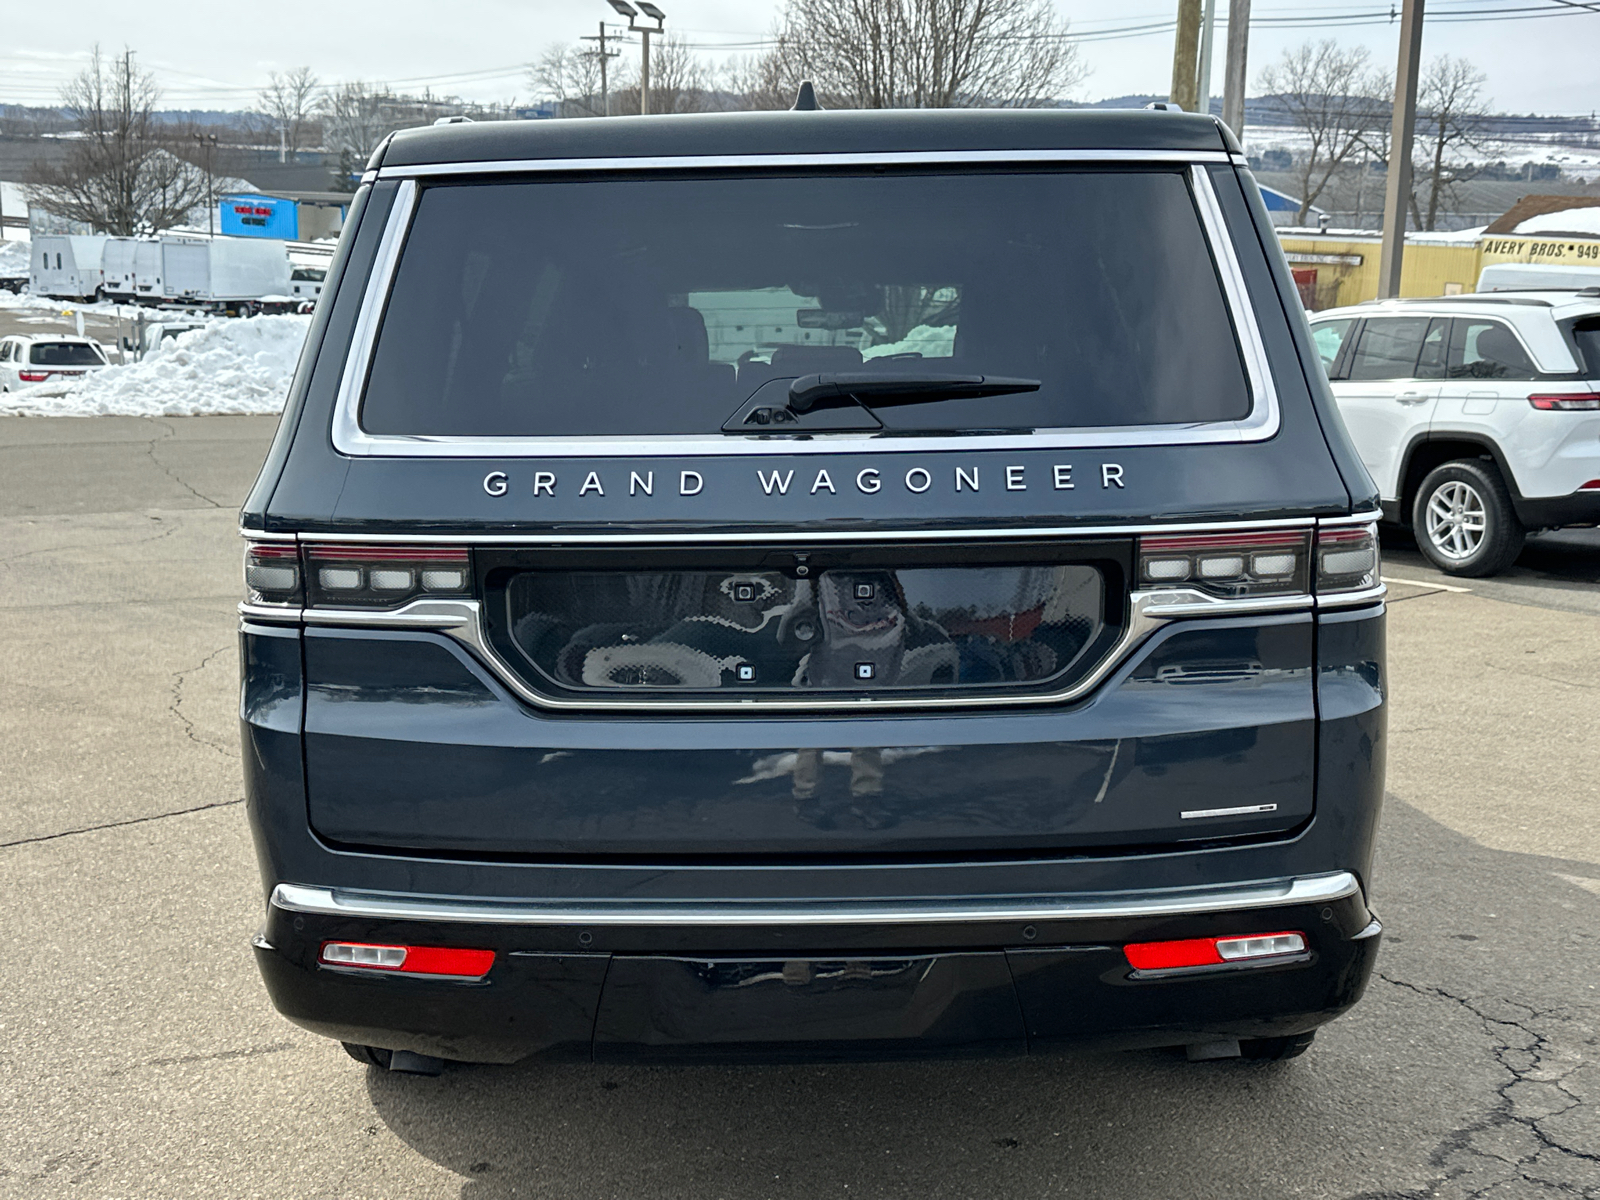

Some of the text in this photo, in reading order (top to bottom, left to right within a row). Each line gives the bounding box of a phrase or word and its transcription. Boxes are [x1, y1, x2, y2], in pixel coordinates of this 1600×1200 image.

[1484, 240, 1526, 255] AVERY
[1529, 242, 1567, 257] BROS.
[482, 463, 1125, 497] GRAND WAGONEER
